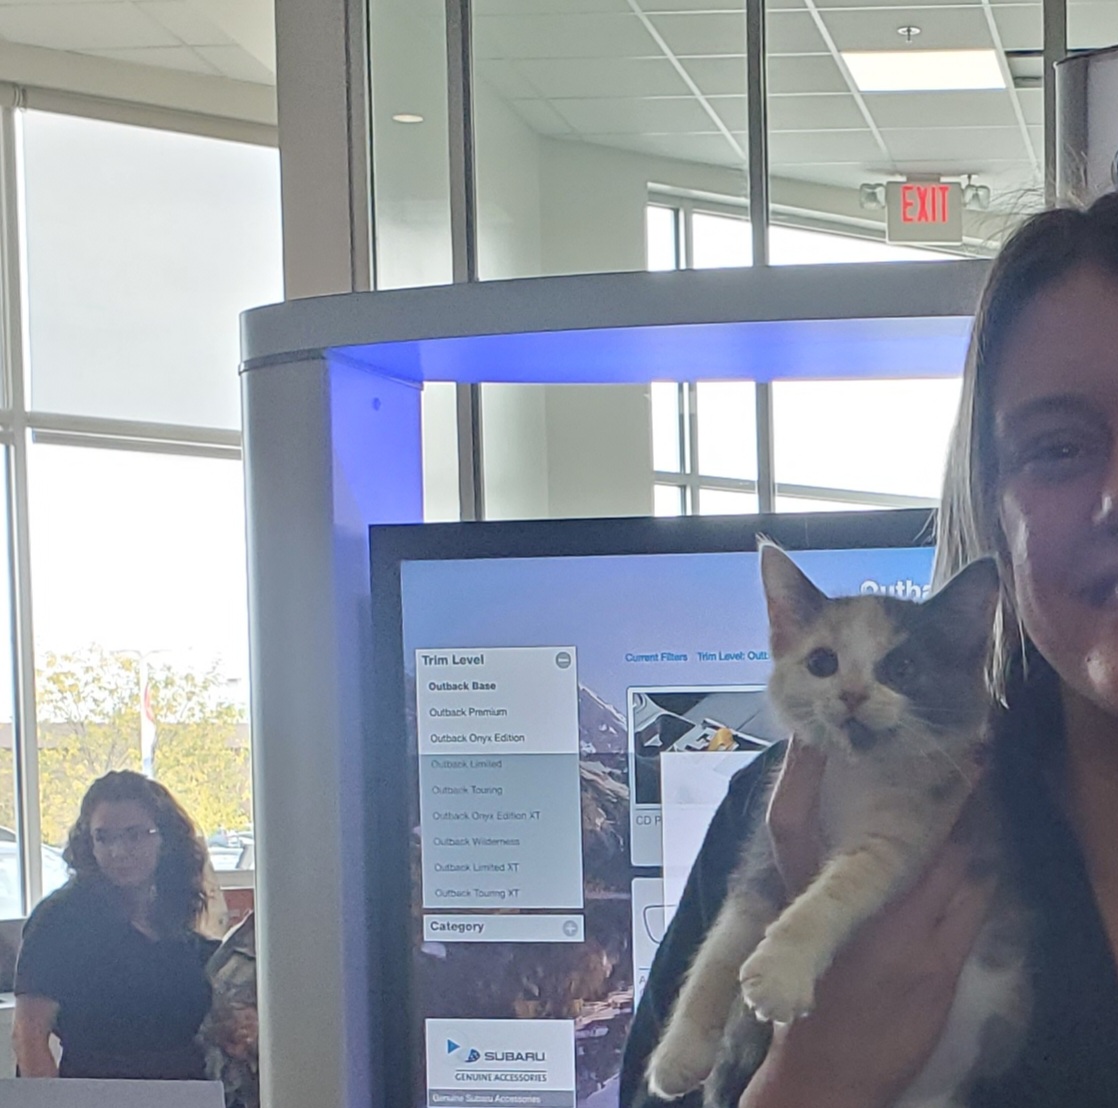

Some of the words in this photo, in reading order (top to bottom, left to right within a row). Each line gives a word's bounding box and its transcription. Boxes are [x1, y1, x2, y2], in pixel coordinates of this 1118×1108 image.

[901, 185, 950, 223] EXIT
[421, 654, 449, 666] Trim
[452, 653, 485, 666] Level
[625, 652, 659, 662] Current
[661, 651, 688, 662] Filters
[697, 651, 717, 661] Trim
[719, 651, 746, 661] Level:
[428, 681, 470, 691] Outback
[472, 681, 497, 691] Base
[429, 707, 467, 717] Outback
[468, 707, 508, 717] Premium
[430, 733, 468, 743] Outback
[469, 733, 493, 745] Onyx
[494, 733, 526, 743] Edition
[430, 760, 468, 769] Outback
[470, 759, 502, 769] Limited
[432, 785, 468, 795] Outback
[471, 785, 503, 796] Touring
[432, 811, 470, 821] Outback
[472, 811, 495, 823] Onyx
[496, 811, 527, 821] Edition
[529, 811, 541, 820] XT
[635, 815, 652, 826] CD
[433, 837, 471, 846] Outback
[472, 837, 520, 846] Wilderness
[434, 863, 471, 872] Outback
[472, 863, 506, 872] Limited
[507, 863, 520, 872] XT
[434, 889, 471, 898] Outback
[474, 889, 506, 899] Touring
[508, 889, 521, 898] XT
[430, 920, 485, 934] Category
[484, 1051, 546, 1062] SUBARU
[454, 1072, 493, 1082] GENUINE
[494, 1072, 548, 1083] ACCESSORIES
[432, 1093, 465, 1103] Genuine
[494, 1094, 542, 1104] Accessories
